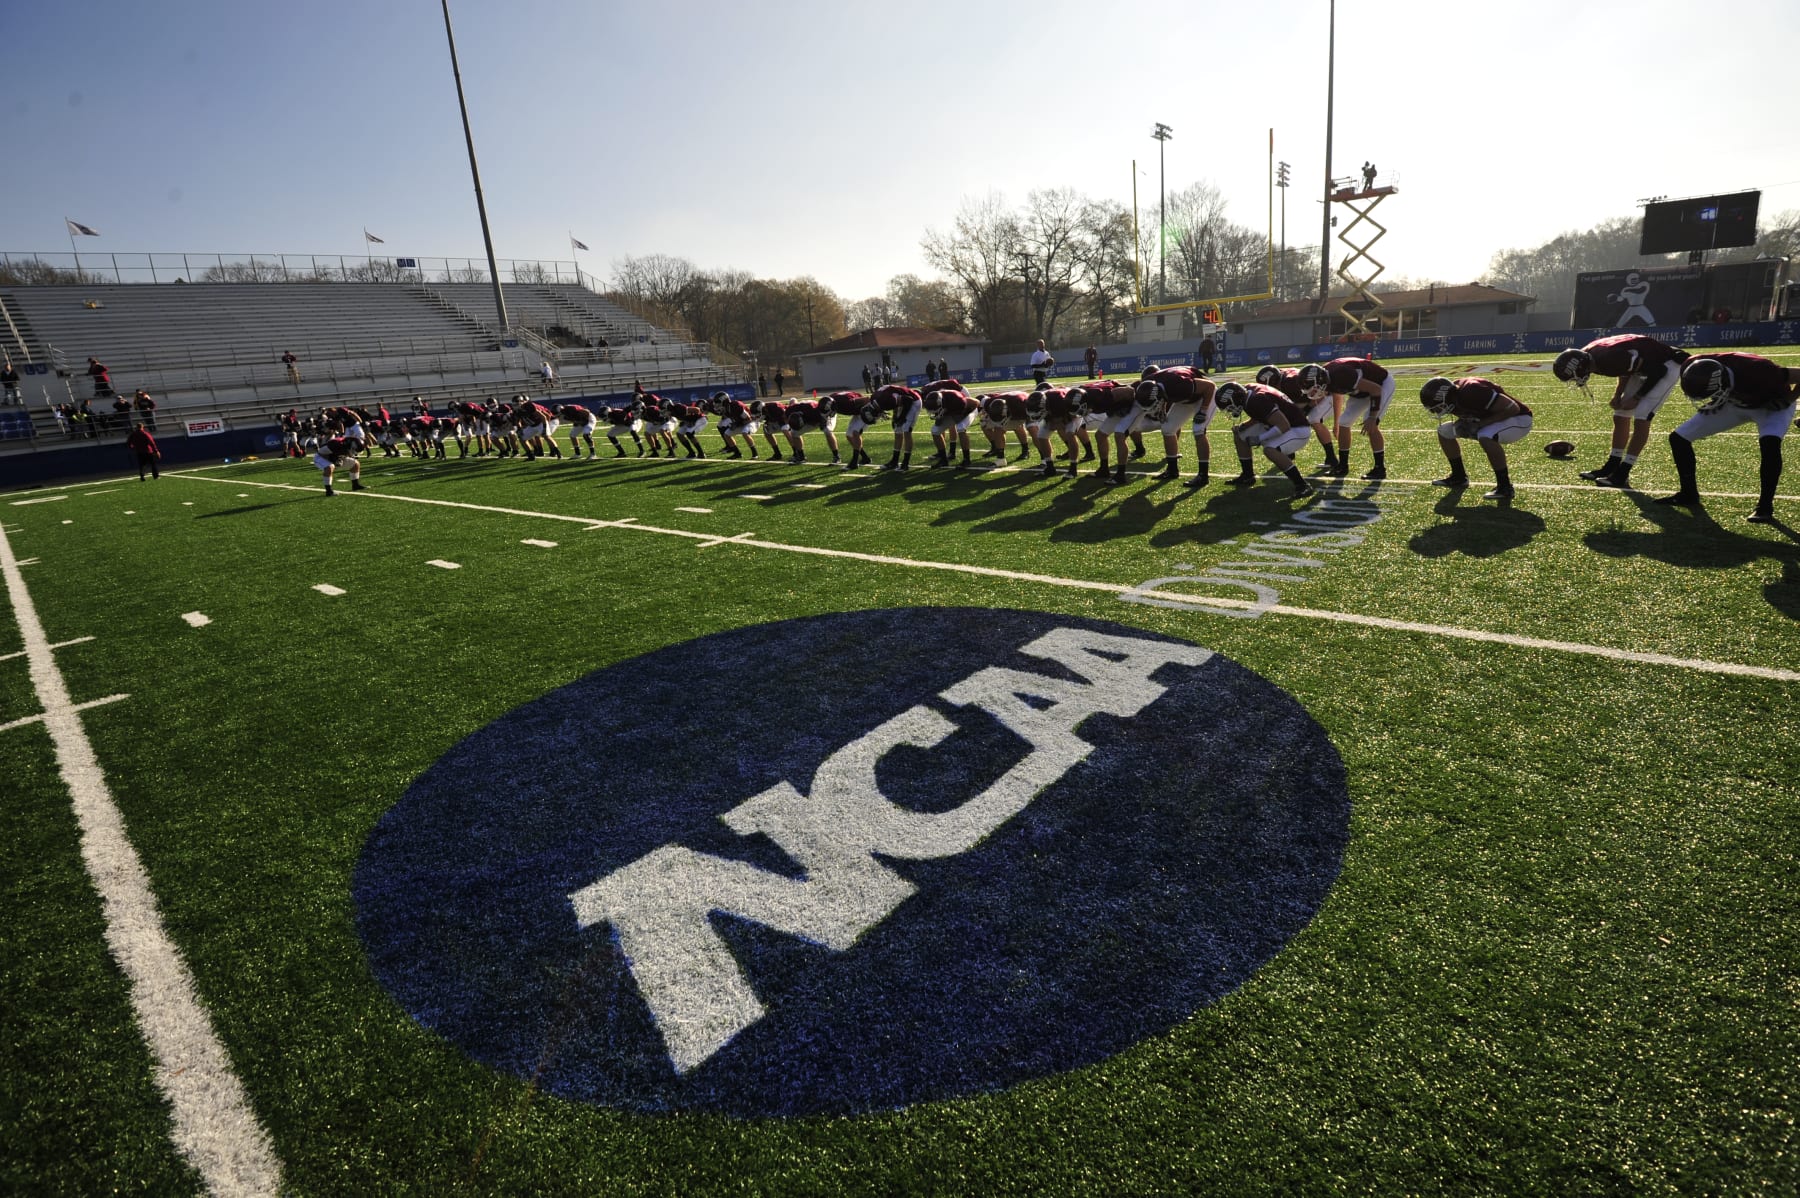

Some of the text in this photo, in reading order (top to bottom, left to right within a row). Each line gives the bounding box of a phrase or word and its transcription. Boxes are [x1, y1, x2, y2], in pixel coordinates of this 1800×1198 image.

[1463, 339, 1497, 350] LEARNING
[1545, 336, 1575, 346] PASSION
[1394, 343, 1421, 353] BALANCE
[189, 421, 220, 431] ESPN
[1117, 500, 1401, 620] Division
[567, 627, 1216, 1075] NCAA
